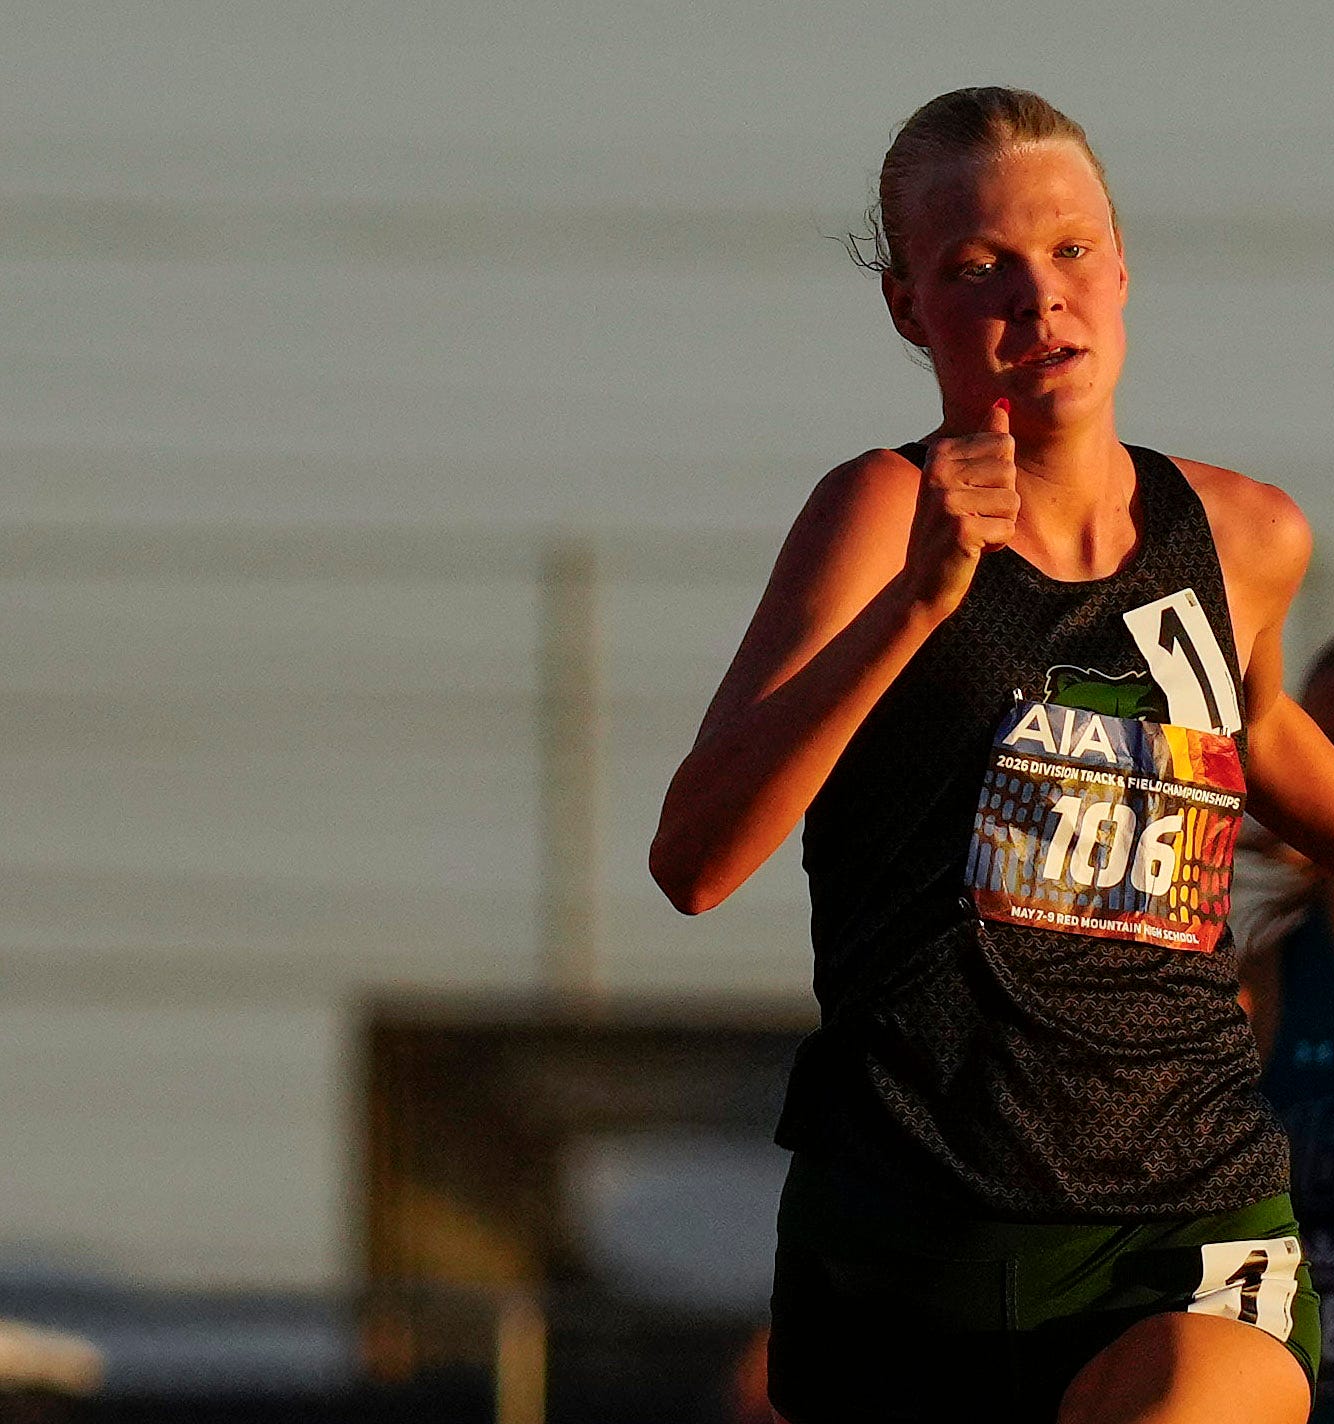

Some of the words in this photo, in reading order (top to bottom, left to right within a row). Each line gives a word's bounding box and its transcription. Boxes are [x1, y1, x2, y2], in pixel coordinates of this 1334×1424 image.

[1158, 606, 1223, 730] 1
[1002, 704, 1117, 763] AIA
[997, 755, 1029, 772] 2026
[1030, 758, 1079, 780] DIVISION
[1080, 768, 1116, 786] TRACK
[1117, 776, 1125, 788] &
[1128, 777, 1162, 794] FIELD
[1163, 783, 1241, 809] CHAMPIONSHIPS
[1043, 795, 1184, 896] 106
[1011, 906, 1034, 920] MAY
[1036, 909, 1055, 924] 7-9
[1056, 912, 1079, 926] RED
[1080, 916, 1142, 935] MOUNTAIN
[1163, 928, 1199, 944] SCHOOL
[1225, 1249, 1268, 1325] 1
